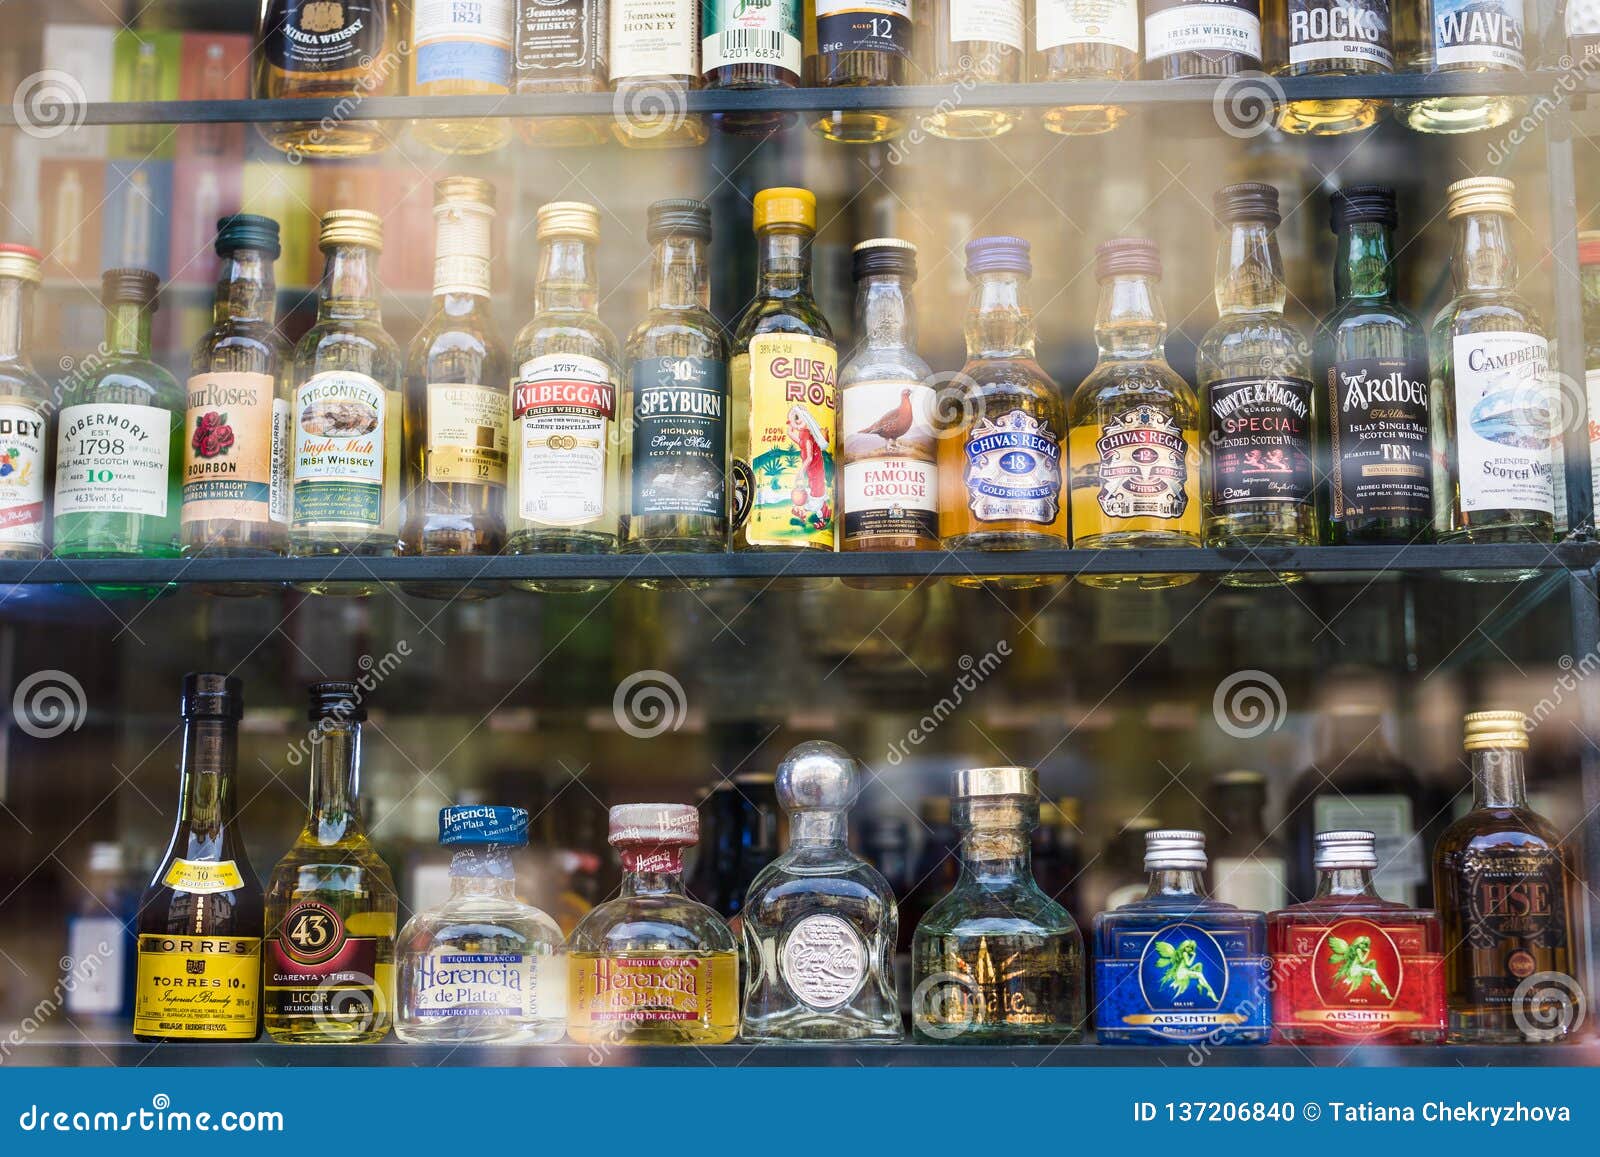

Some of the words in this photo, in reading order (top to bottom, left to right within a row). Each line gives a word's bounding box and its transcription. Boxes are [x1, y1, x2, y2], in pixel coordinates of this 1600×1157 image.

[452, 11, 481, 24] 1824
[526, 7, 577, 17] Tennessee
[624, 10, 676, 20] Tennessee
[283, 24, 319, 44] NIKKA
[320, 18, 363, 43] WHISKY
[527, 21, 577, 32] WHISKEY
[624, 21, 676, 32] HONEY
[869, 18, 893, 39] 12
[1291, 7, 1380, 43] ROCKS
[1437, 11, 1522, 50] WAVES
[1168, 27, 1199, 38] IRISH
[1203, 26, 1249, 39] WHISKEY
[722, 49, 749, 59] 4201
[755, 49, 781, 59] 6854
[673, 361, 691, 381] 10
[206, 383, 257, 408] Roses
[302, 385, 378, 410] TYRCONNELL
[516, 385, 611, 411] KILBEGGAN
[1212, 386, 1253, 420] WHYTE
[1266, 382, 1308, 419] MACKAY
[641, 391, 720, 417] SPEYBURN
[530, 407, 554, 416] IRISH
[557, 406, 599, 416] WHISKEY
[64, 414, 149, 442] TOBERMORY
[764, 427, 784, 435] 100%
[1227, 417, 1300, 433] SPECIAL
[1350, 424, 1376, 433] ISLAY
[1379, 421, 1410, 431] SINGLE
[1412, 423, 1428, 433] MALT
[661, 428, 704, 436] HIGHLAND
[1359, 431, 1396, 440] SCOTCH
[1398, 431, 1423, 441] WHISKY
[651, 436, 682, 451] Single
[684, 436, 711, 449] Malt
[761, 435, 786, 443] AGAVE
[1102, 431, 1146, 451] CHIVAS
[1150, 431, 1184, 453] REGAL
[1251, 435, 1282, 445] SCOTCH
[79, 439, 125, 455] 1798
[300, 438, 335, 457] Single
[338, 439, 373, 455] Malt
[971, 434, 1018, 455] CHIVAS
[1022, 434, 1057, 458] REGAL
[1380, 443, 1411, 461] TEN
[300, 457, 324, 466] IRISH
[328, 455, 374, 467] WHISKEY
[1139, 450, 1151, 461] 12
[133, 460, 164, 470] WHISKY
[188, 462, 236, 476] BOURBON
[884, 461, 906, 469] THE
[1009, 455, 1026, 470] 18
[86, 469, 113, 483] 10
[272, 457, 280, 491] ROSES
[477, 465, 489, 476] 12
[1103, 467, 1138, 477] BLENDED
[1156, 467, 1184, 478] SCOTCH
[1483, 460, 1529, 479] SCOTCH
[864, 470, 925, 483] FAMOUS
[210, 482, 247, 490] STRAIGHT
[864, 484, 925, 497] GROUSE
[982, 485, 1006, 496] GOLD
[1007, 486, 1050, 497] SIGNATURE
[1129, 483, 1162, 493] WHISKY
[210, 490, 244, 498] WHISKEY
[444, 806, 496, 829] Herencia
[463, 820, 484, 829] Plata
[636, 849, 671, 872] Herencia
[197, 871, 208, 881] 10
[1482, 882, 1551, 917] HSE
[291, 915, 328, 945] 43
[152, 941, 246, 953] TORRES
[273, 973, 318, 981] CUARENTA
[330, 973, 355, 981] TRES
[418, 955, 521, 992] Herencia
[592, 960, 697, 995] Herencia
[153, 977, 221, 987] TORRES
[158, 990, 195, 1005] Imperial
[194, 990, 232, 1008] Brandy
[292, 993, 328, 1003] LICOR
[435, 989, 453, 1002] de
[456, 989, 498, 1003] Plata
[611, 994, 629, 1006] de
[632, 993, 675, 1006] Plata
[441, 1008, 466, 1016] PURO
[468, 1008, 480, 1016] DE
[482, 1008, 510, 1016] AGAVE
